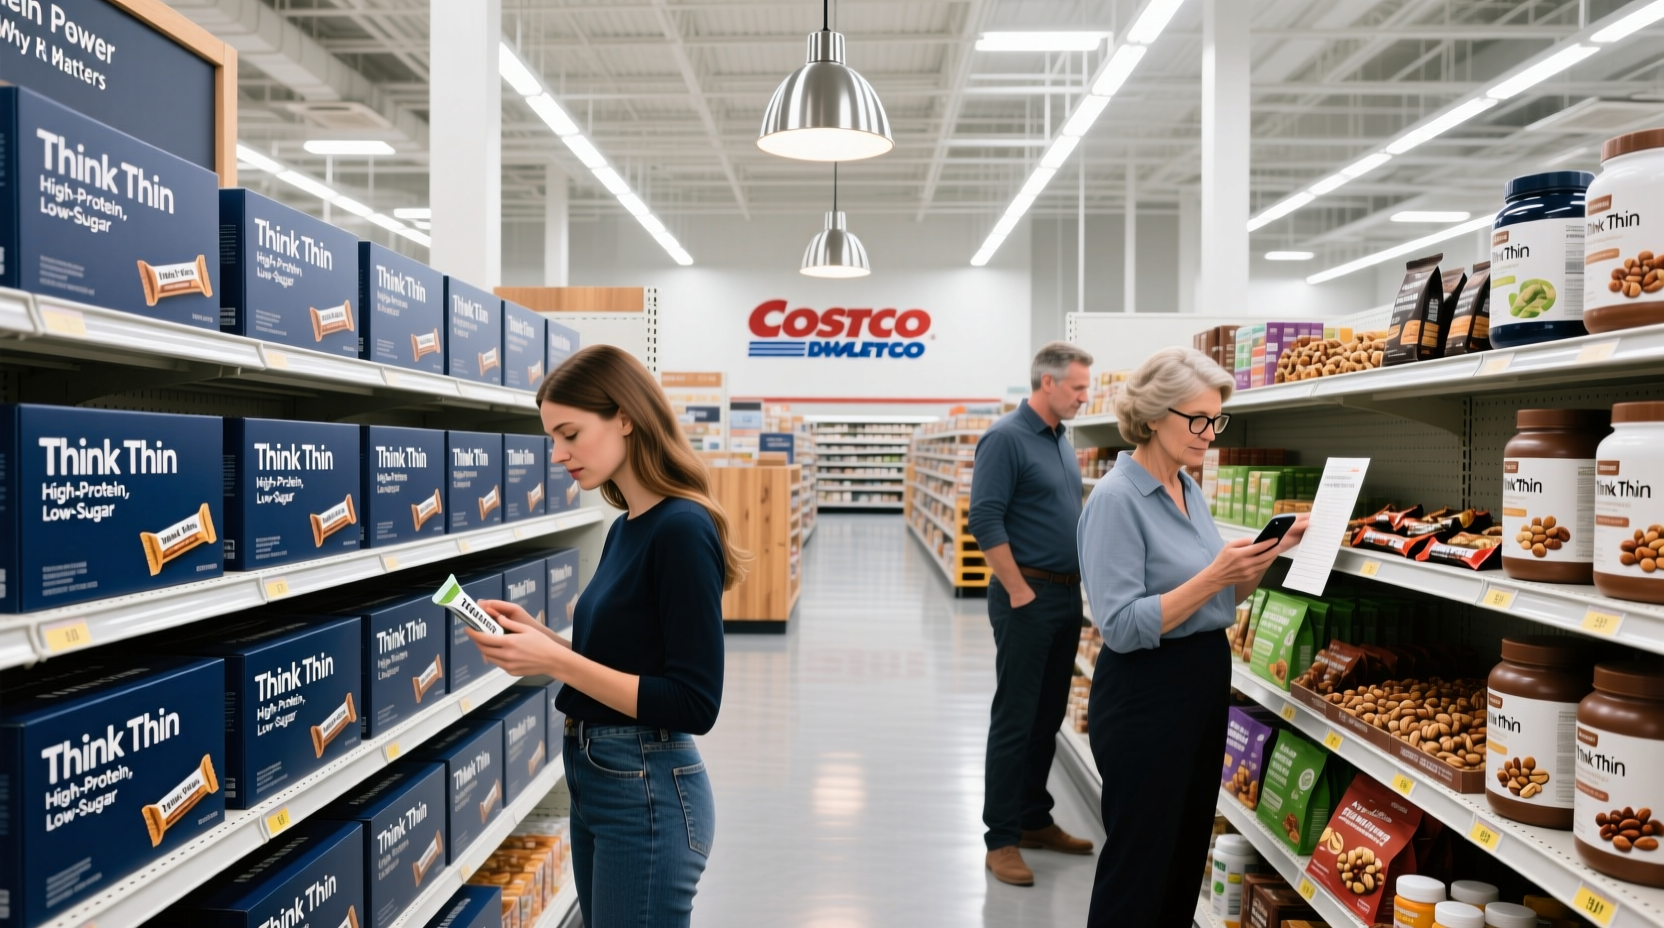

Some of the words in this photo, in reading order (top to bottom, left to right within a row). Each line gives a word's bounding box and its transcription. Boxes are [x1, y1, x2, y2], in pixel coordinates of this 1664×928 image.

[51, 4, 116, 64] Power
[52, 45, 106, 90] Matters
[36, 128, 118, 194] Think
[121, 162, 174, 214] Thin
[40, 175, 128, 221] High-Protein,
[40, 198, 112, 233] Low-Sugar
[1606, 210, 1640, 231] Thin
[254, 217, 300, 260] Think
[300, 235, 333, 271] Thin
[376, 265, 405, 296] Think
[748, 299, 932, 339] COSTCO
[38, 437, 121, 476] Think
[123, 440, 178, 474] Thin
[254, 443, 301, 471] Think
[301, 444, 334, 471] Thin
[376, 446, 405, 468] Think
[41, 481, 130, 504] High-Protein,
[1618, 479, 1652, 499] Thin
[42, 502, 115, 522] Low-Sugar
[376, 624, 405, 655] Think
[254, 661, 302, 702] Think
[302, 652, 334, 685] Thin
[41, 724, 124, 785] Think
[126, 708, 180, 752] Thin
[1594, 754, 1626, 778] Thin
[45, 764, 133, 811] High-Protein,
[46, 789, 118, 832] Low-Sugar
[377, 817, 406, 855] Think
[305, 874, 337, 912] Thin
